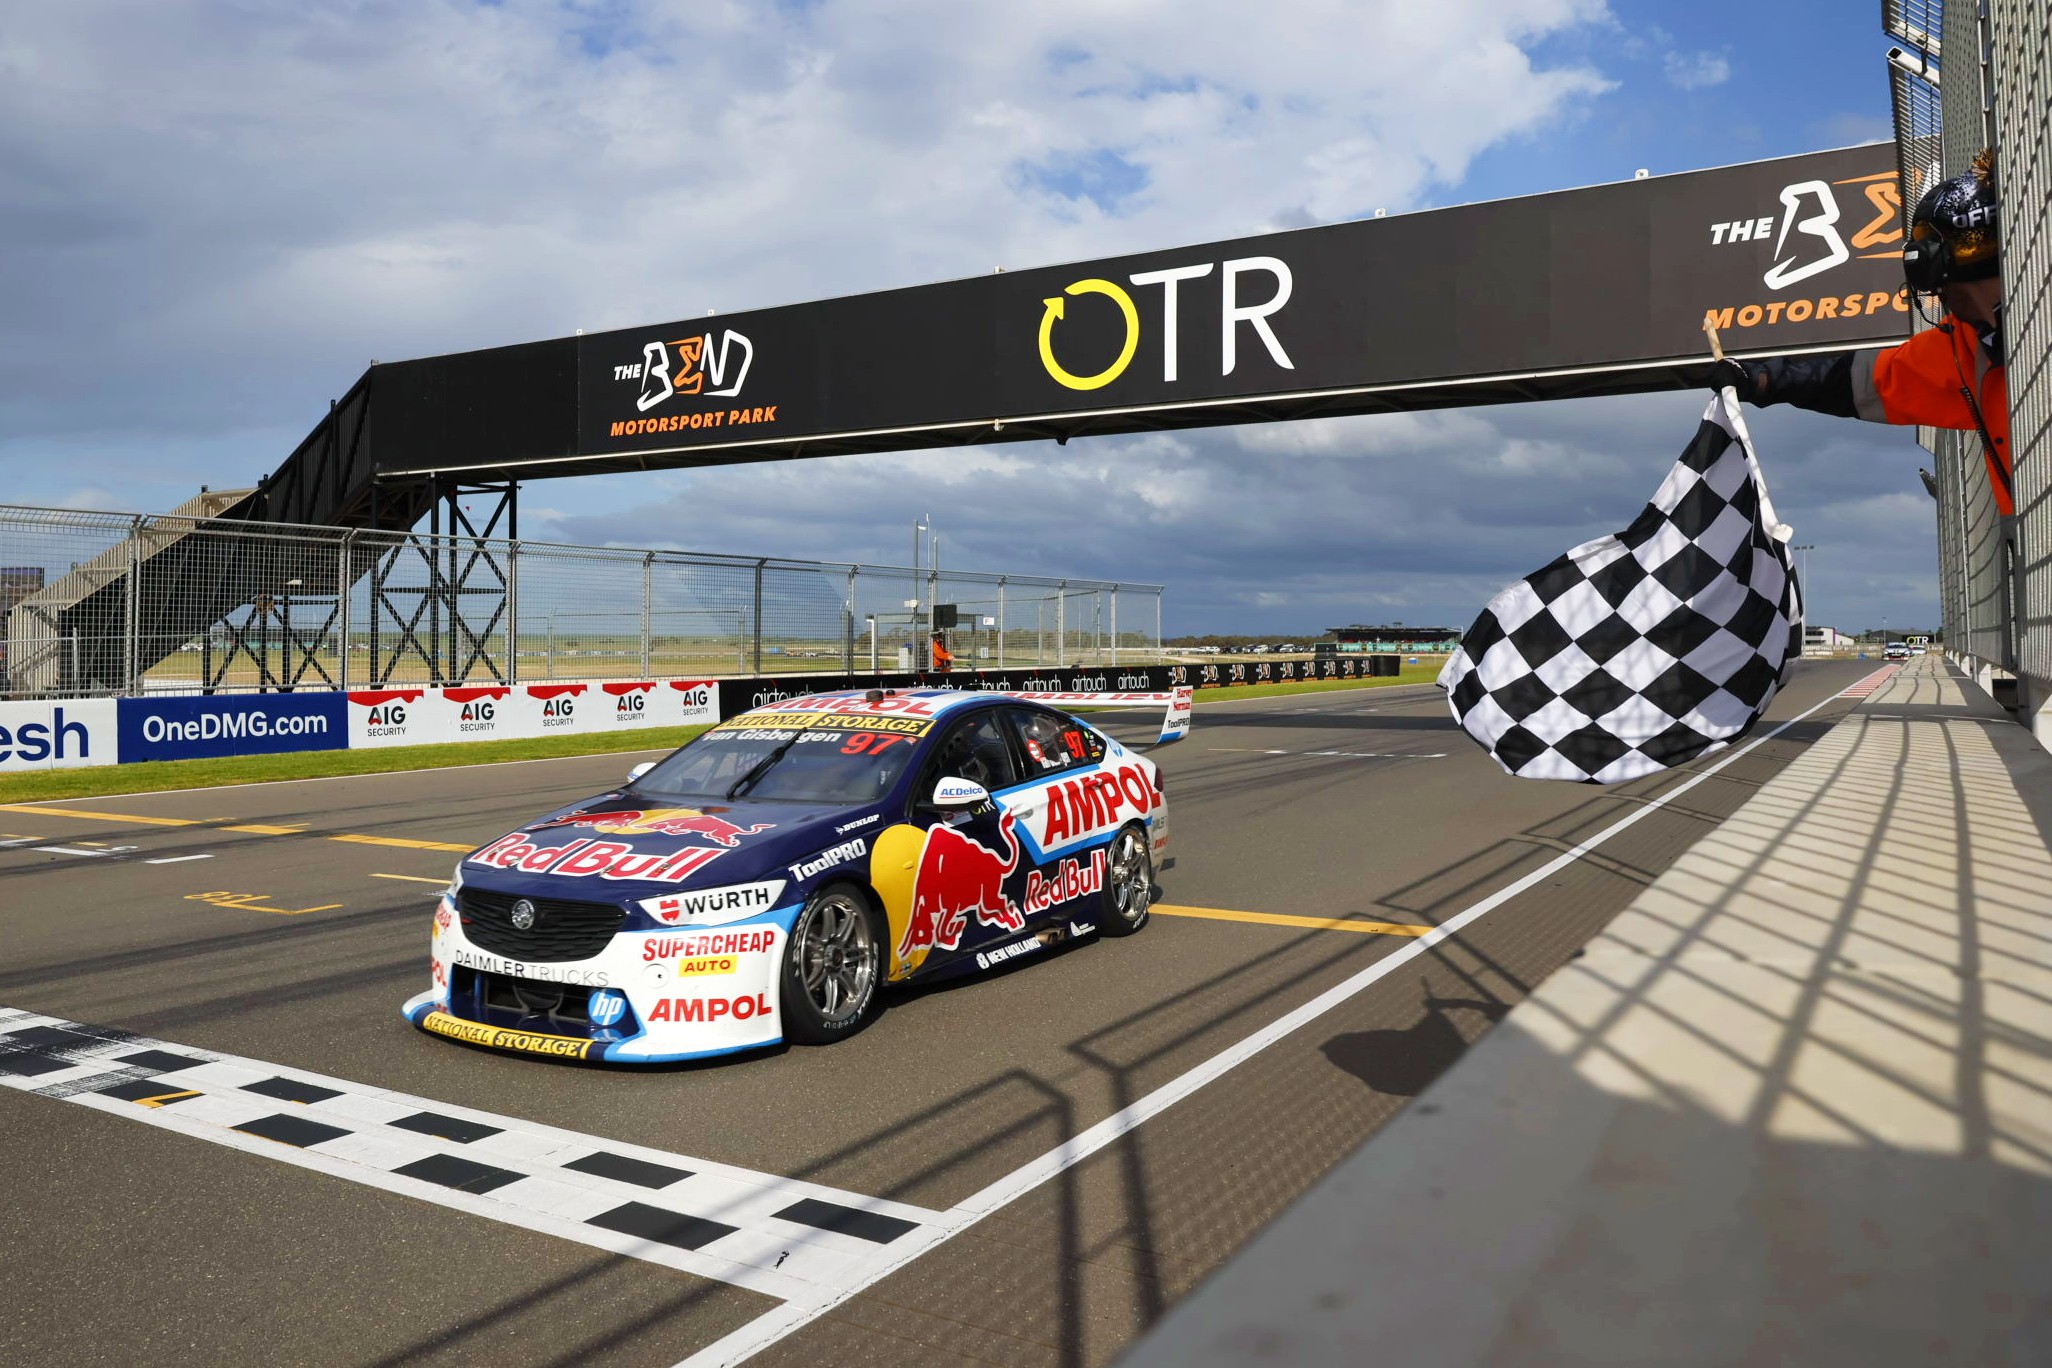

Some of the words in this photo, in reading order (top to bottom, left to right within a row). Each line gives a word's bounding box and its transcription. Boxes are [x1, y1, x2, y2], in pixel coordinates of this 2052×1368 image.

[1710, 216, 1774, 245] THE
[1702, 289, 1909, 331] MOTORSPO
[1038, 256, 1295, 391] OTR
[614, 363, 642, 381] THE
[610, 411, 725, 437] MOTORSPORT
[728, 405, 778, 426] PARK
[1906, 636, 1929, 645] OTR
[1072, 672, 1107, 692] airtouch
[1118, 670, 1150, 690] airtouch
[543, 699, 574, 717] AIG
[617, 695, 645, 712] AIG
[683, 690, 708, 706] AIG
[756, 697, 935, 716] AMPOL
[368, 706, 406, 726] AIG
[461, 702, 495, 721] AIG
[616, 713, 645, 722] SECURITY
[682, 707, 709, 716] SECURITY
[143, 711, 328, 743] OneDMG.com
[367, 727, 406, 737] SECURITY
[460, 722, 495, 732] SECURITY
[542, 718, 574, 727] SECURITY
[817, 714, 925, 734] STORAGE
[737, 729, 843, 744] Gisbegen
[840, 732, 900, 756] 97
[1063, 730, 1087, 759] 97
[940, 787, 983, 796] ACDelco
[1043, 763, 1161, 847] AMPOL
[842, 814, 880, 832] DUNLOP
[788, 838, 867, 882] ToolPRO
[684, 887, 769, 915] WÜRTH
[643, 931, 775, 961] SUPERCHEAP
[986, 947, 1009, 964] NEW
[1005, 936, 1042, 957] HOLLAND
[455, 950, 525, 978] DAIMLER
[529, 964, 609, 987] TRUCKS
[684, 960, 731, 972] AUTO
[591, 990, 624, 1026] hp
[648, 993, 772, 1022] AMPOL
[428, 1015, 489, 1043] NATIONAL
[495, 1032, 581, 1057] STORAGE
